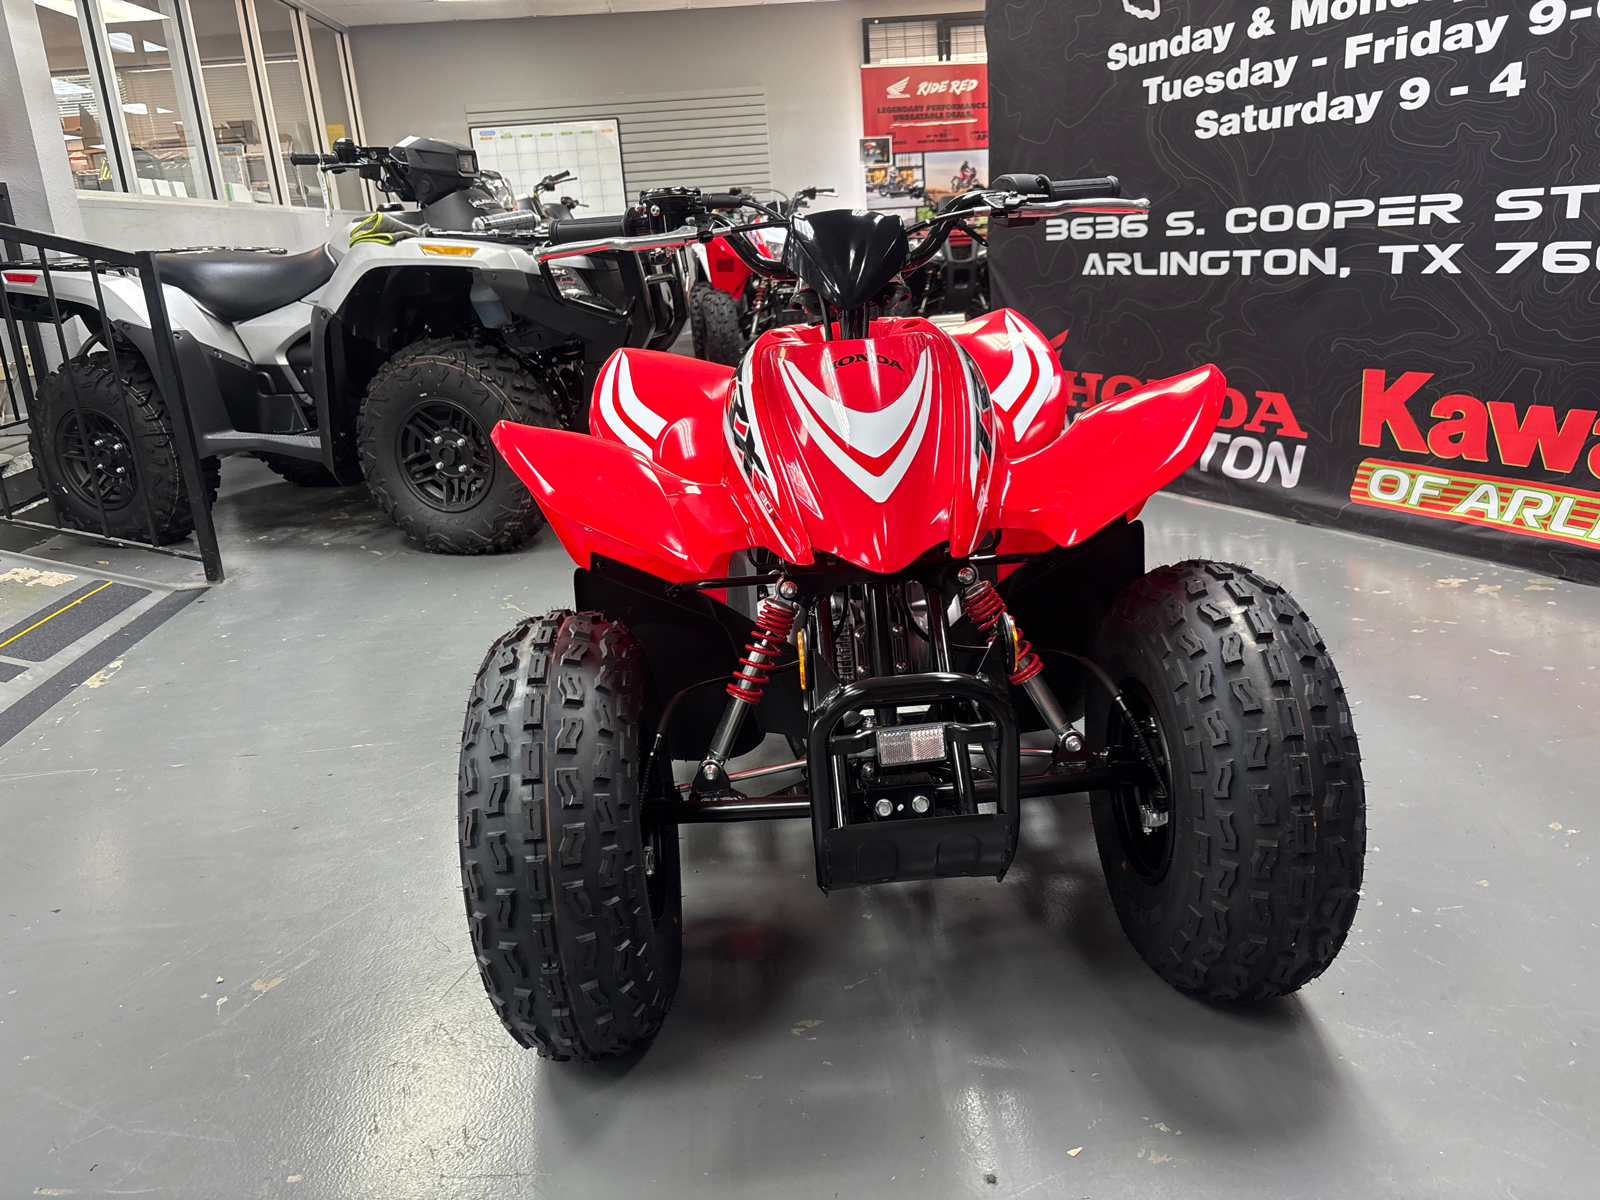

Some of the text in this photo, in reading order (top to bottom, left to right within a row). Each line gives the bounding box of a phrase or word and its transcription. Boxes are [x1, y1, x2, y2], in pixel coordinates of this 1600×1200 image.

[1106, 22, 1236, 71] Sunday
[1246, 7, 1276, 40] &
[1142, 55, 1299, 105] Tuesday
[1344, 15, 1510, 70] Friday
[877, 105, 925, 114] LEGENDARY
[916, 78, 979, 97] RIDE RED
[1194, 90, 1384, 140] Saturday
[1399, 76, 1431, 111] 9
[1489, 61, 1527, 98] 4
[1045, 213, 1149, 241] 3636
[1165, 210, 1205, 237] S.
[1225, 192, 1464, 234] COOPER
[1081, 240, 1600, 279] ARLINGTON, TX 76
[1359, 368, 1600, 480] Kaw
[1368, 468, 1600, 540] OF ARL
